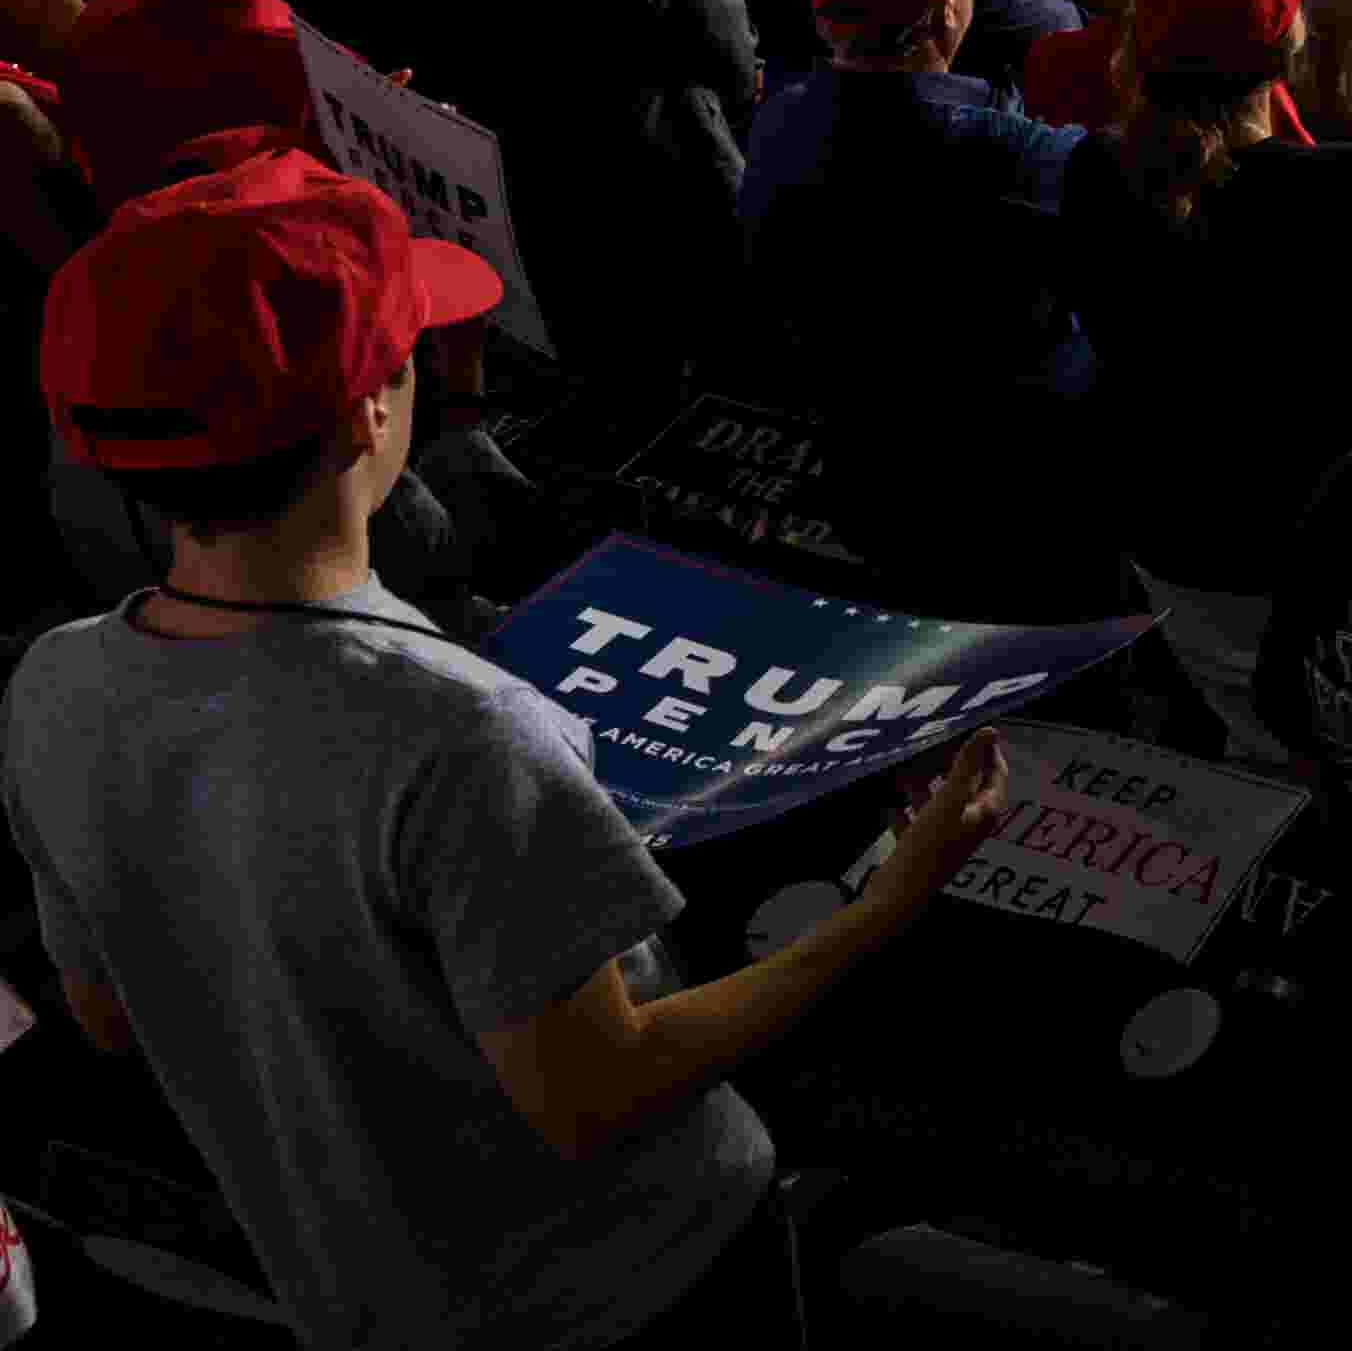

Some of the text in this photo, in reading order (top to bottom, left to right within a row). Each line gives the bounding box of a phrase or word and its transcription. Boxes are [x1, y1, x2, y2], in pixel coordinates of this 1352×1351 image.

[323, 89, 488, 224] TRUMP
[568, 605, 1049, 720] TRUMP
[555, 664, 968, 753] PENCE
[599, 727, 734, 775] AMERICA
[1053, 758, 1178, 809] KEEP
[948, 856, 1111, 928] GREAT
